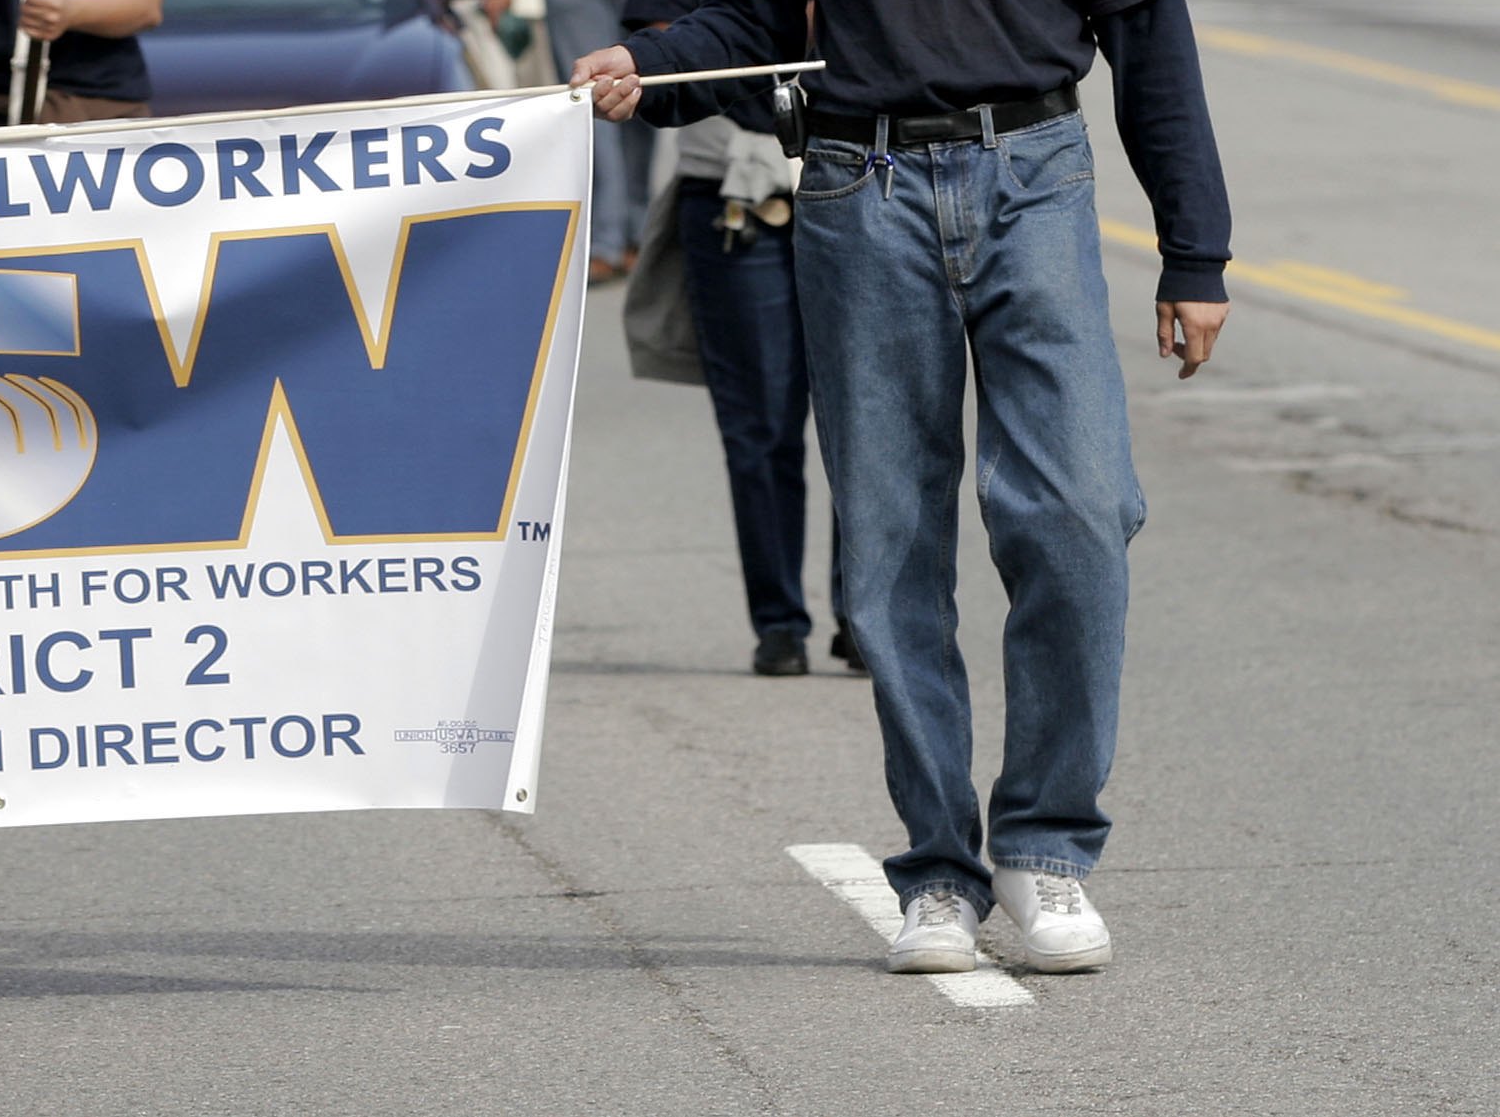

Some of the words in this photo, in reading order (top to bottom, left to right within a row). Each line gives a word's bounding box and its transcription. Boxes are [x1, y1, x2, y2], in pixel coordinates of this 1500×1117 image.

[517, 521, 551, 542] TM
[82, 565, 192, 606] FOR
[206, 556, 482, 599] WORKERS
[184, 624, 231, 687] 2
[29, 713, 366, 772] DIRECTOR
[397, 731, 435, 741] UNION
[438, 729, 475, 741] USWA
[440, 742, 477, 755] 3657
